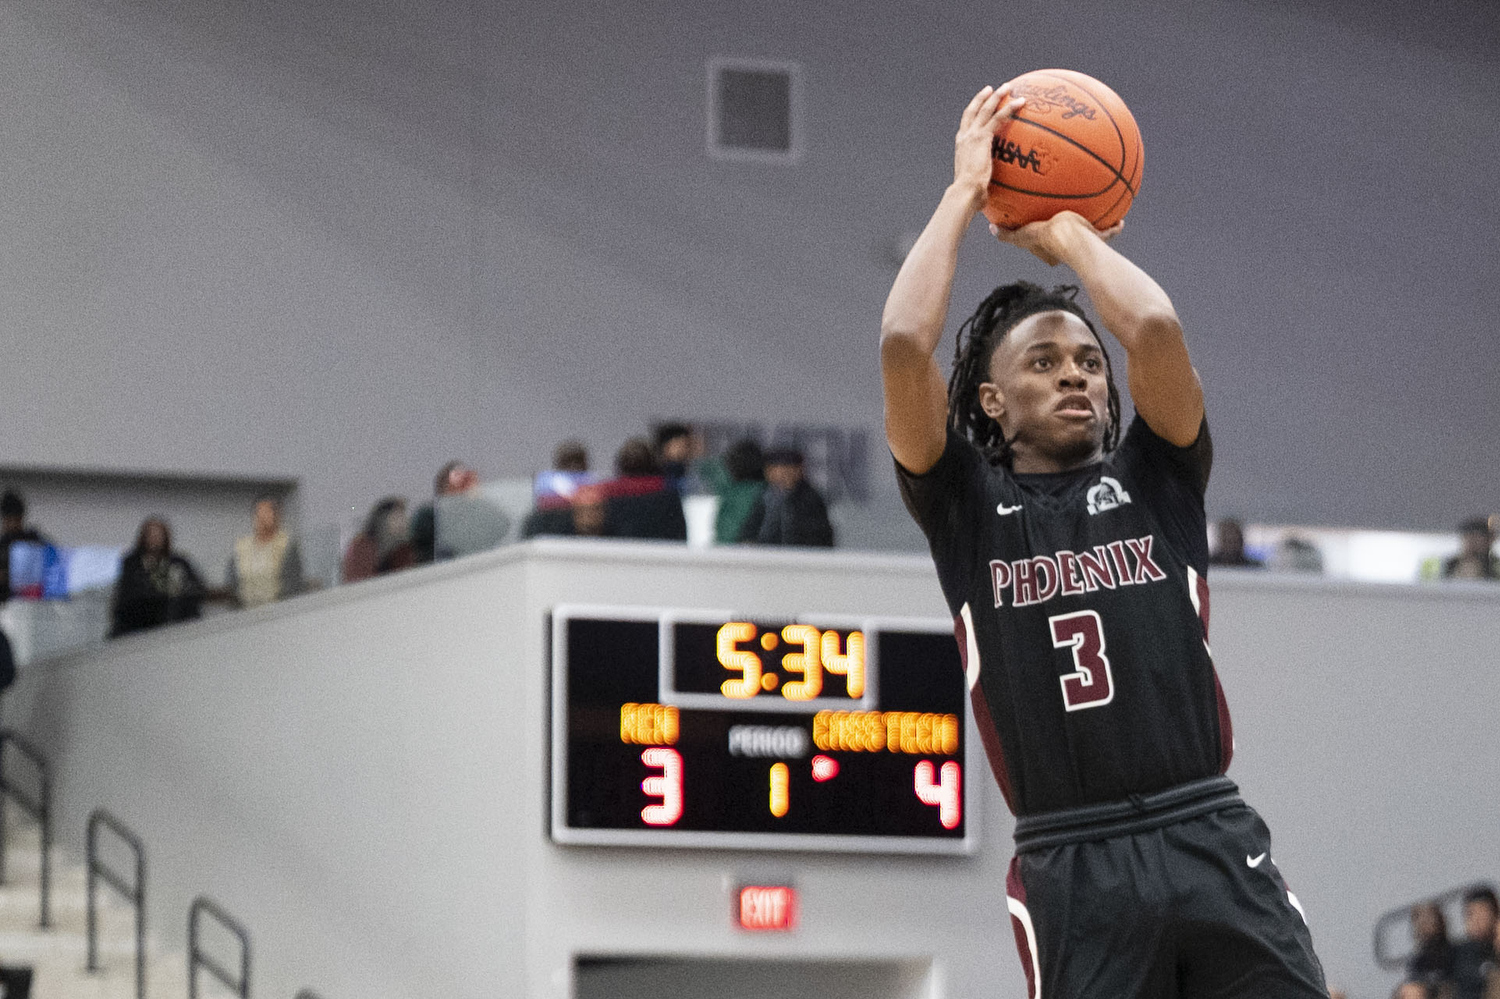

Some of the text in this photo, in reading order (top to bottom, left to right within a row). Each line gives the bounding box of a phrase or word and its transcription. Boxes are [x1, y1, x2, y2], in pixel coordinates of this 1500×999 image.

[989, 535, 1166, 608] PHOENIX
[717, 622, 866, 700] 5:34
[1048, 609, 1114, 712] 3
[728, 724, 808, 758] PERIOD
[641, 747, 684, 826] 3
[769, 762, 789, 817] 1
[914, 760, 962, 829] 4
[741, 887, 790, 930] EXIT
